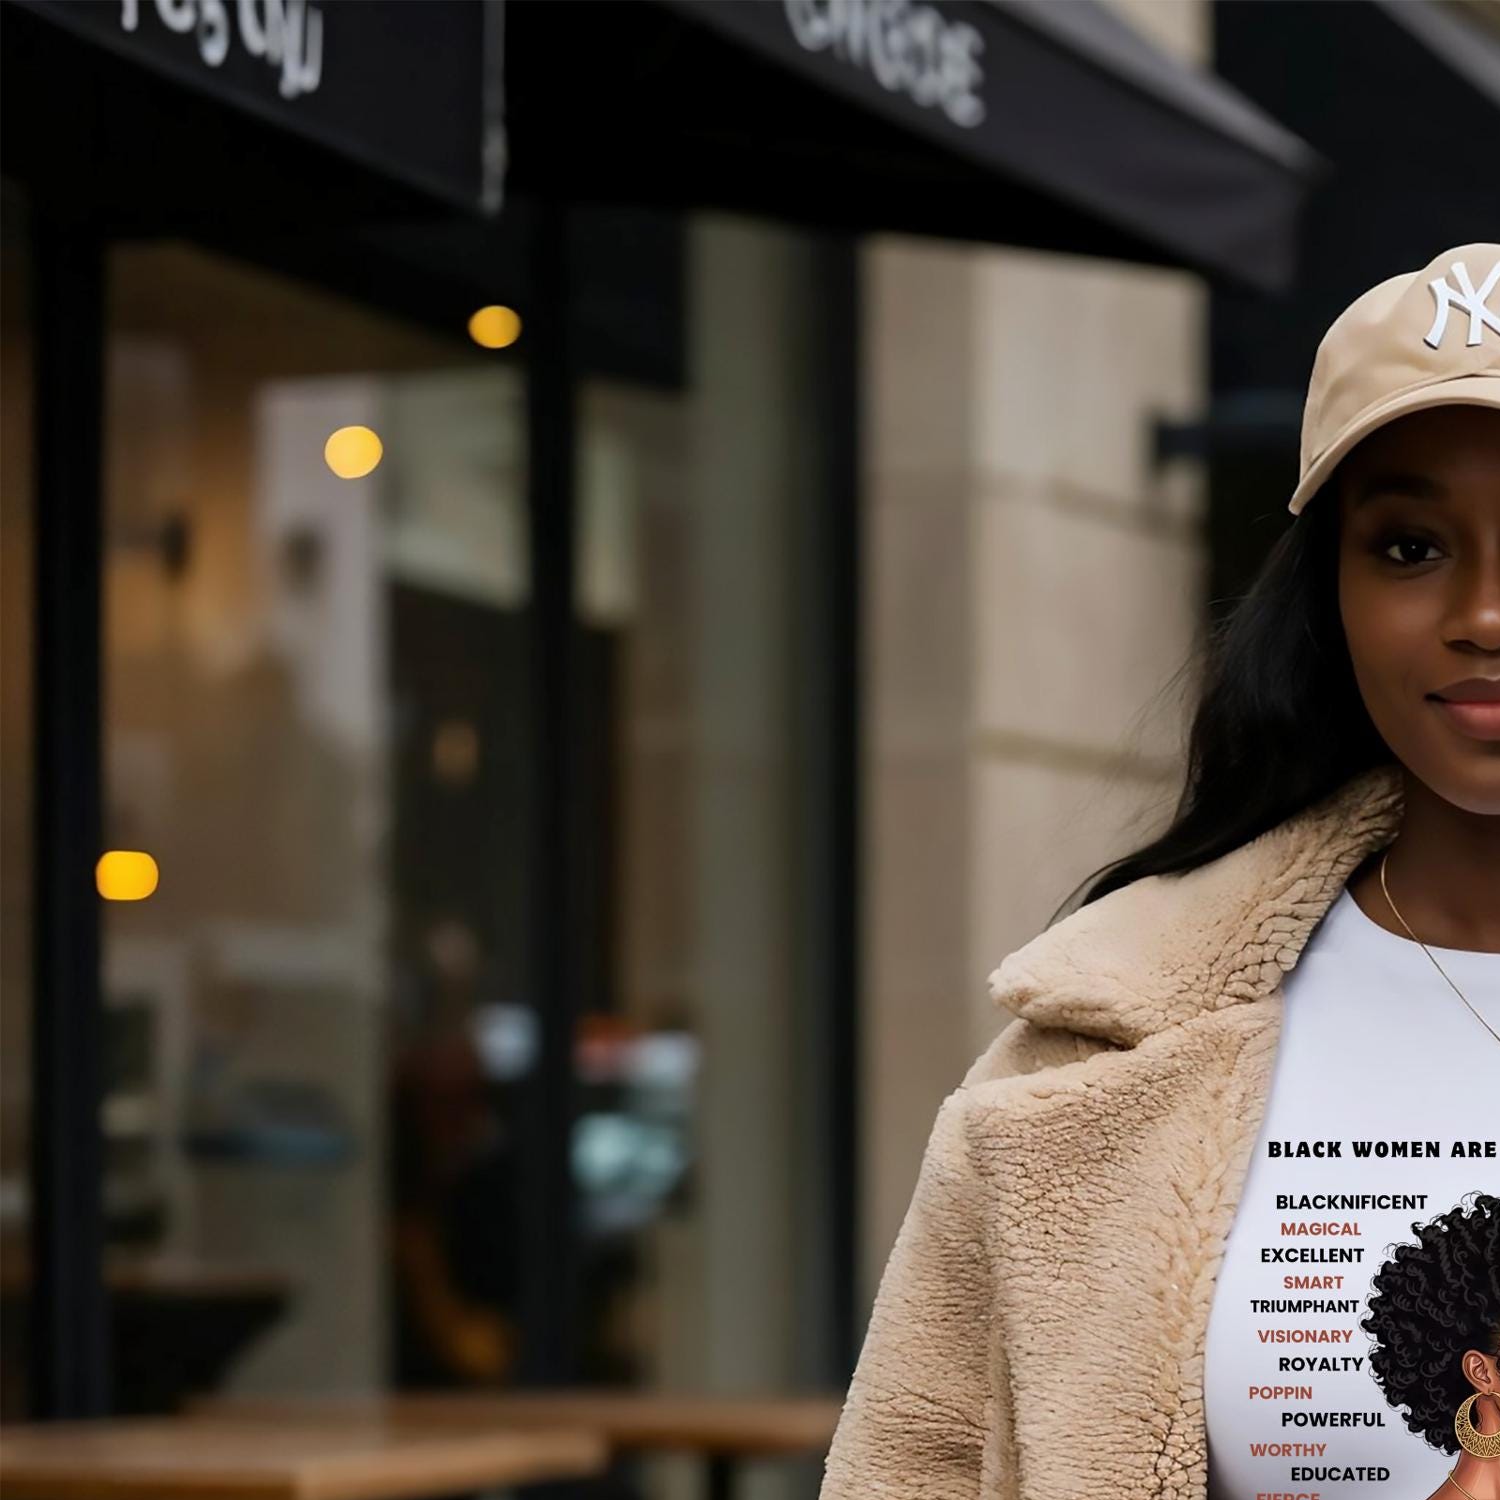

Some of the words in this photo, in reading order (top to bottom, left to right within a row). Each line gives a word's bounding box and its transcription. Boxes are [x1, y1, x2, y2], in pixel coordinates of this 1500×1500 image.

[1267, 1141, 1342, 1159] BLACK
[1351, 1141, 1441, 1159] WOMEN
[1450, 1141, 1497, 1158] ARE
[1276, 1194, 1429, 1210] BLACKNIFICENT
[1280, 1222, 1362, 1236] MAGICAL
[1261, 1247, 1365, 1263] EXCELLENT
[1283, 1275, 1345, 1290] SMART
[1249, 1299, 1360, 1313] TRIUMPHANT
[1257, 1329, 1353, 1344] VISIONARY
[1279, 1356, 1364, 1372] ROYALTY
[1249, 1385, 1313, 1400] POPPIN
[1281, 1412, 1386, 1428] POWERFUL
[1249, 1443, 1327, 1457] WORTHY
[1291, 1466, 1391, 1482] EDUCATED
